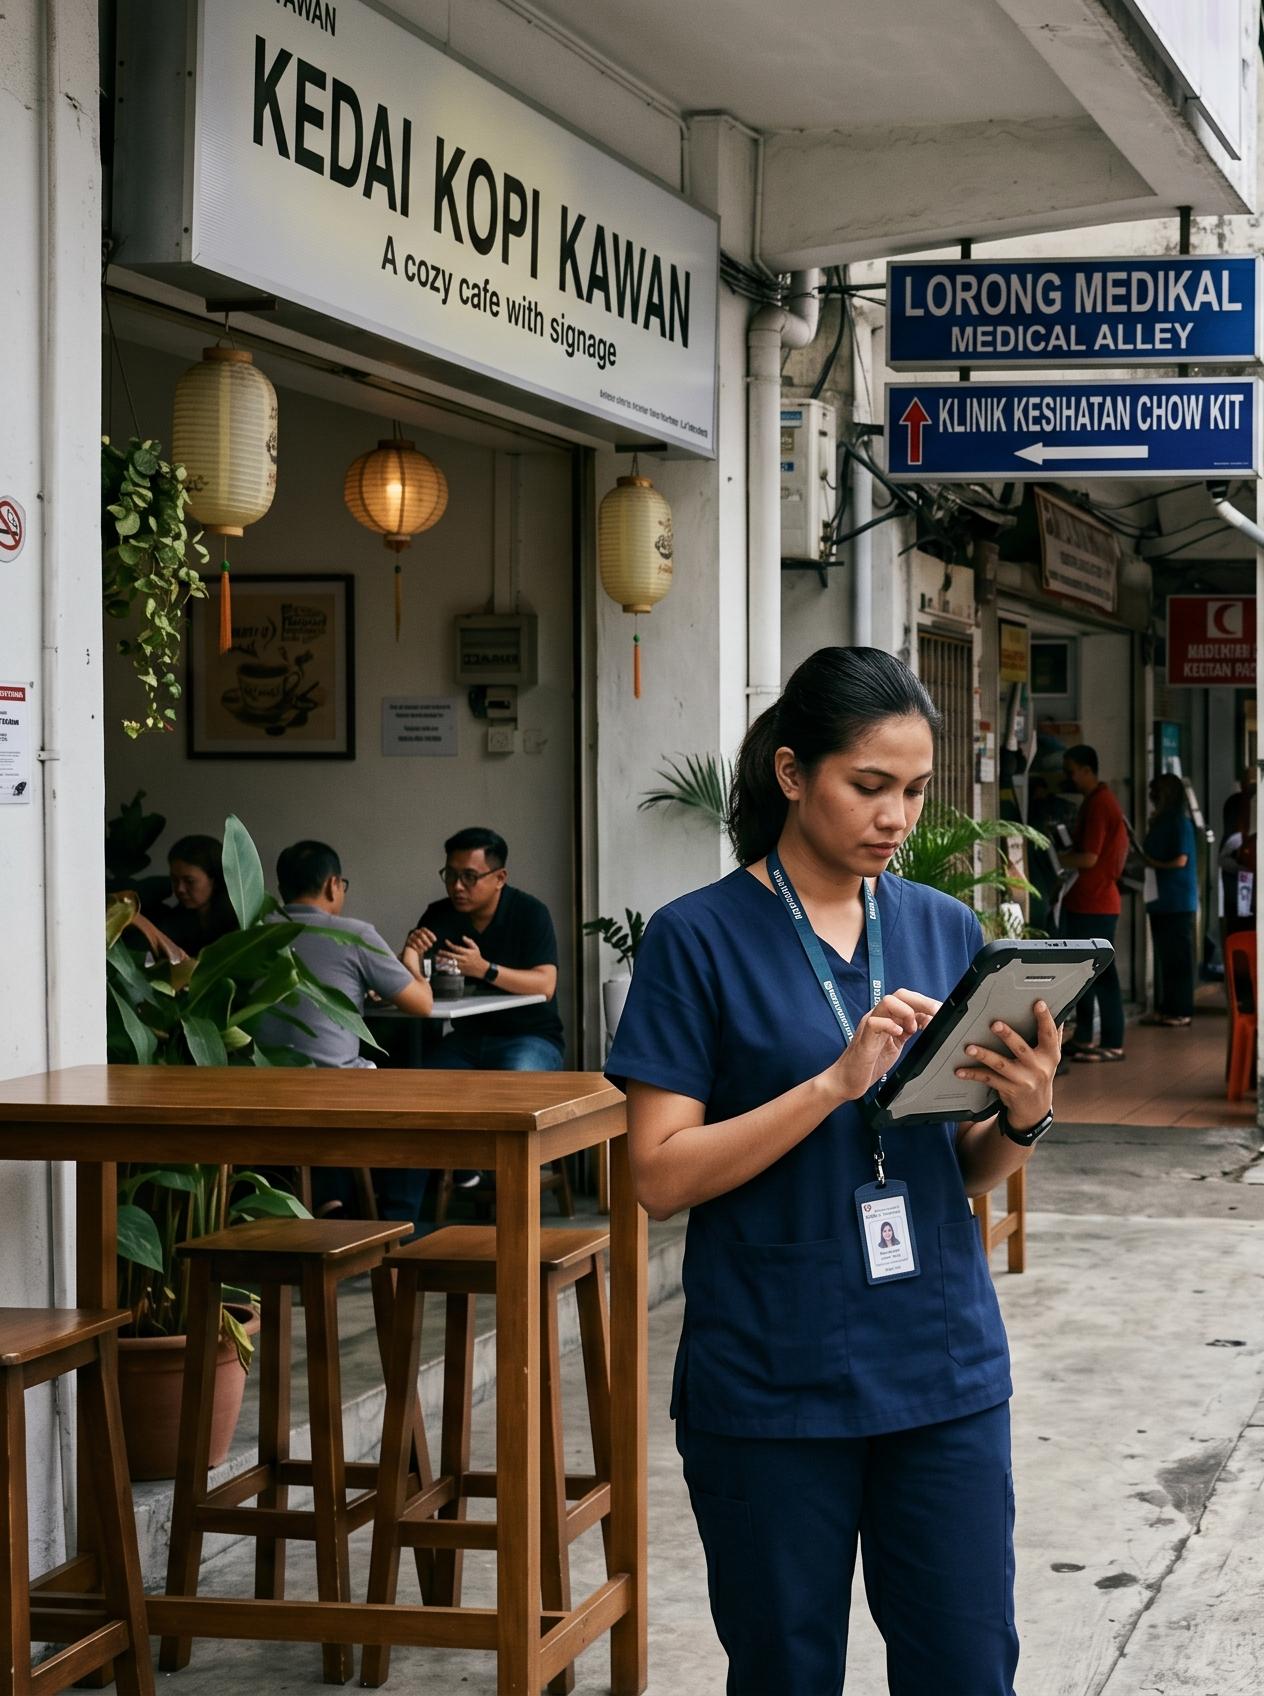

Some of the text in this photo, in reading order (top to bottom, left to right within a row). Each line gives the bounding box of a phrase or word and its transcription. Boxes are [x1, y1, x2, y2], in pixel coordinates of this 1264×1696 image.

[275, 0, 337, 37] WAN
[252, 33, 691, 349] KEDAI KOPI KAWAN
[381, 235, 617, 371] A cozy cafe with signage
[905, 270, 1243, 316] LORONG MEDIKAL
[951, 322, 1194, 353] MEDICAL ALLEY
[939, 393, 1244, 433] KLINIK KESIHATAN CHOW KIT
